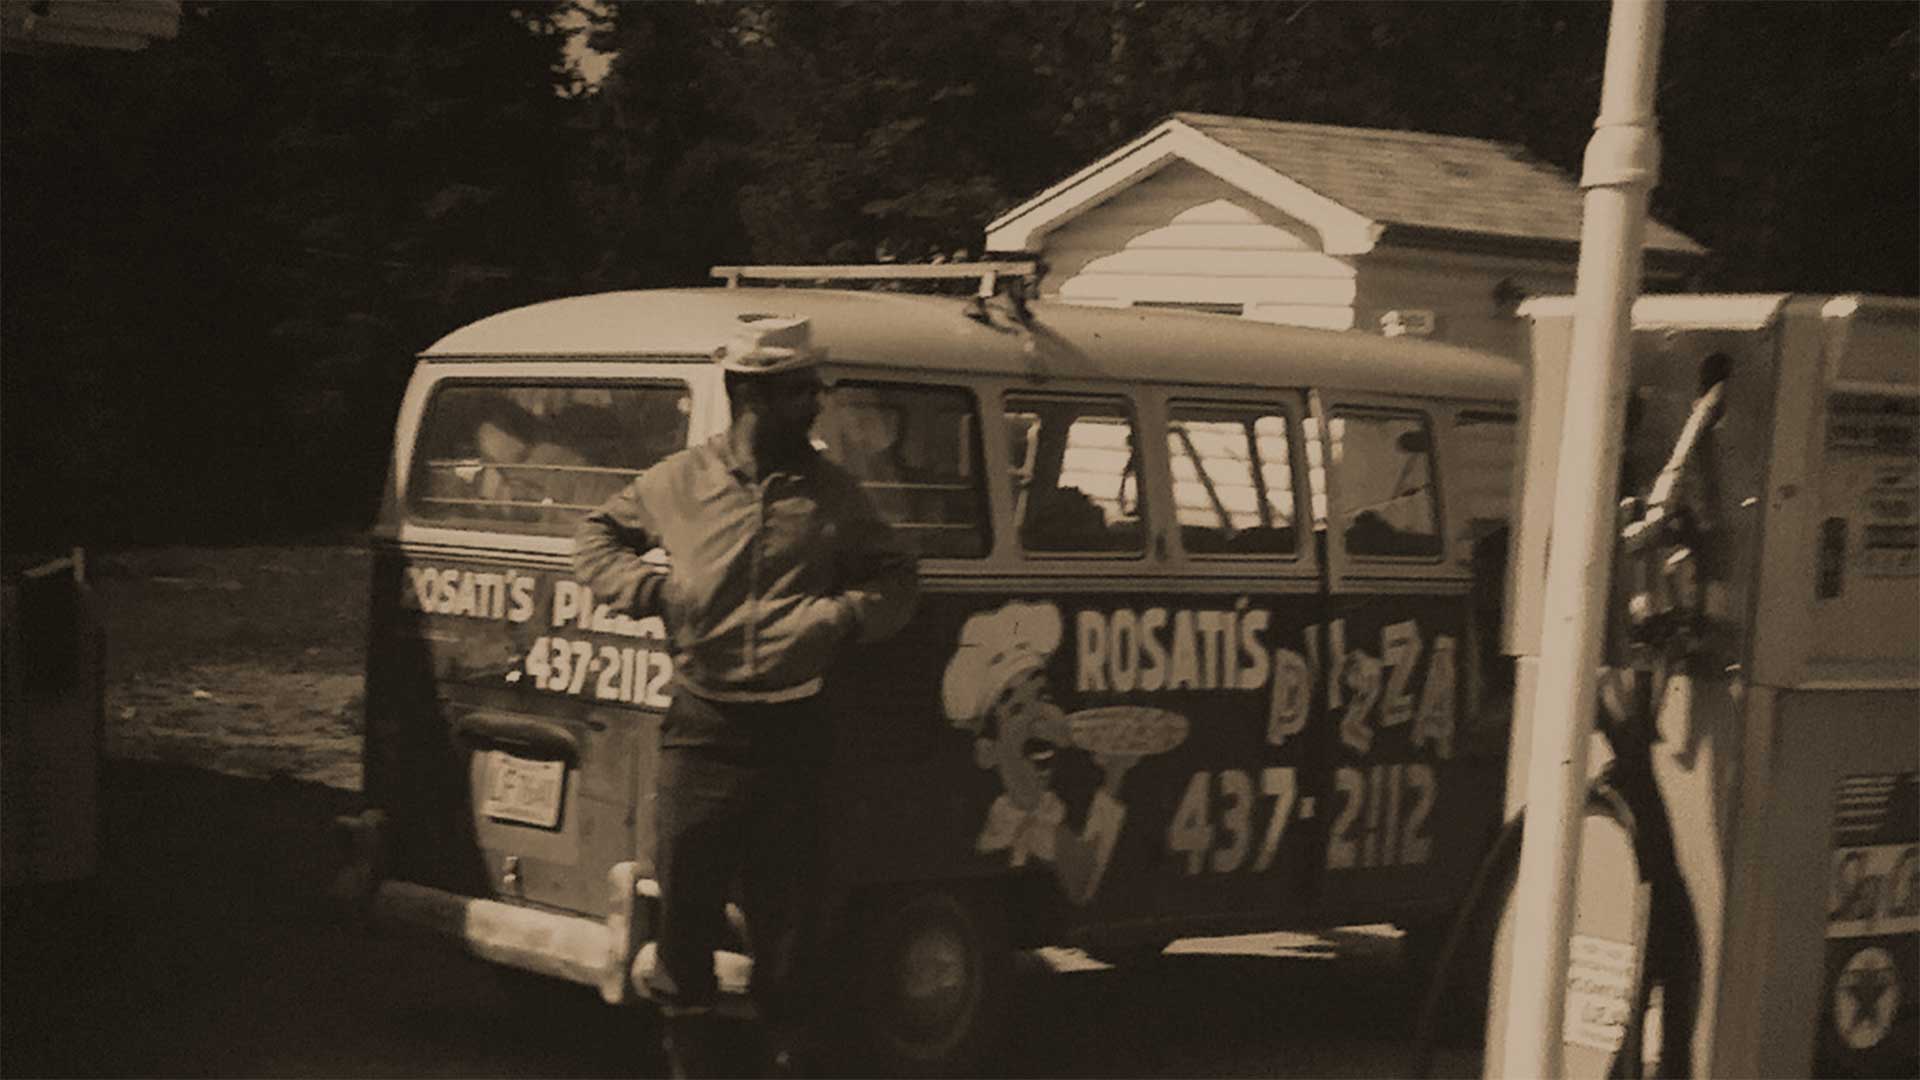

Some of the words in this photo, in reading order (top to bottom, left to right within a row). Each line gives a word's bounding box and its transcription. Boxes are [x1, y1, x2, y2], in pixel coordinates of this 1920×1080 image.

[525, 636, 674, 708] 437-2112
[1077, 597, 1271, 692] ROSATI'S
[1266, 617, 1457, 760] PIZZA
